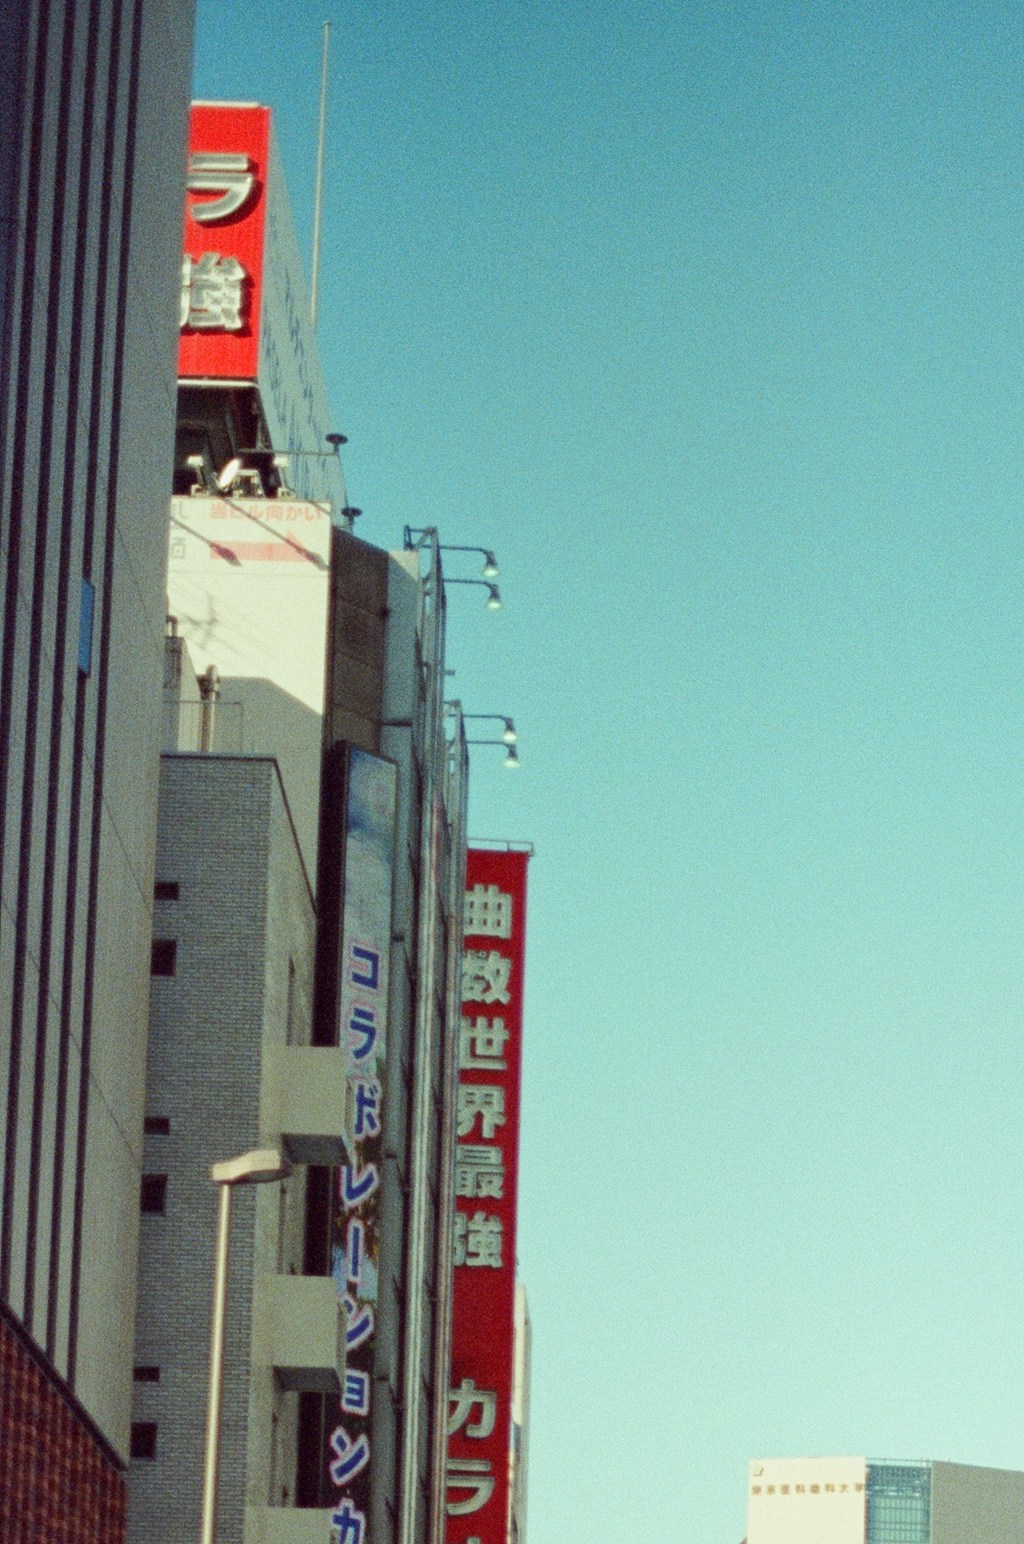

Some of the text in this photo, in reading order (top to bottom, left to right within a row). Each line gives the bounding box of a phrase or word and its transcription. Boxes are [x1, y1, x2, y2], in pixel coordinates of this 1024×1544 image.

[453, 884, 514, 1270] 曲数世界最強
